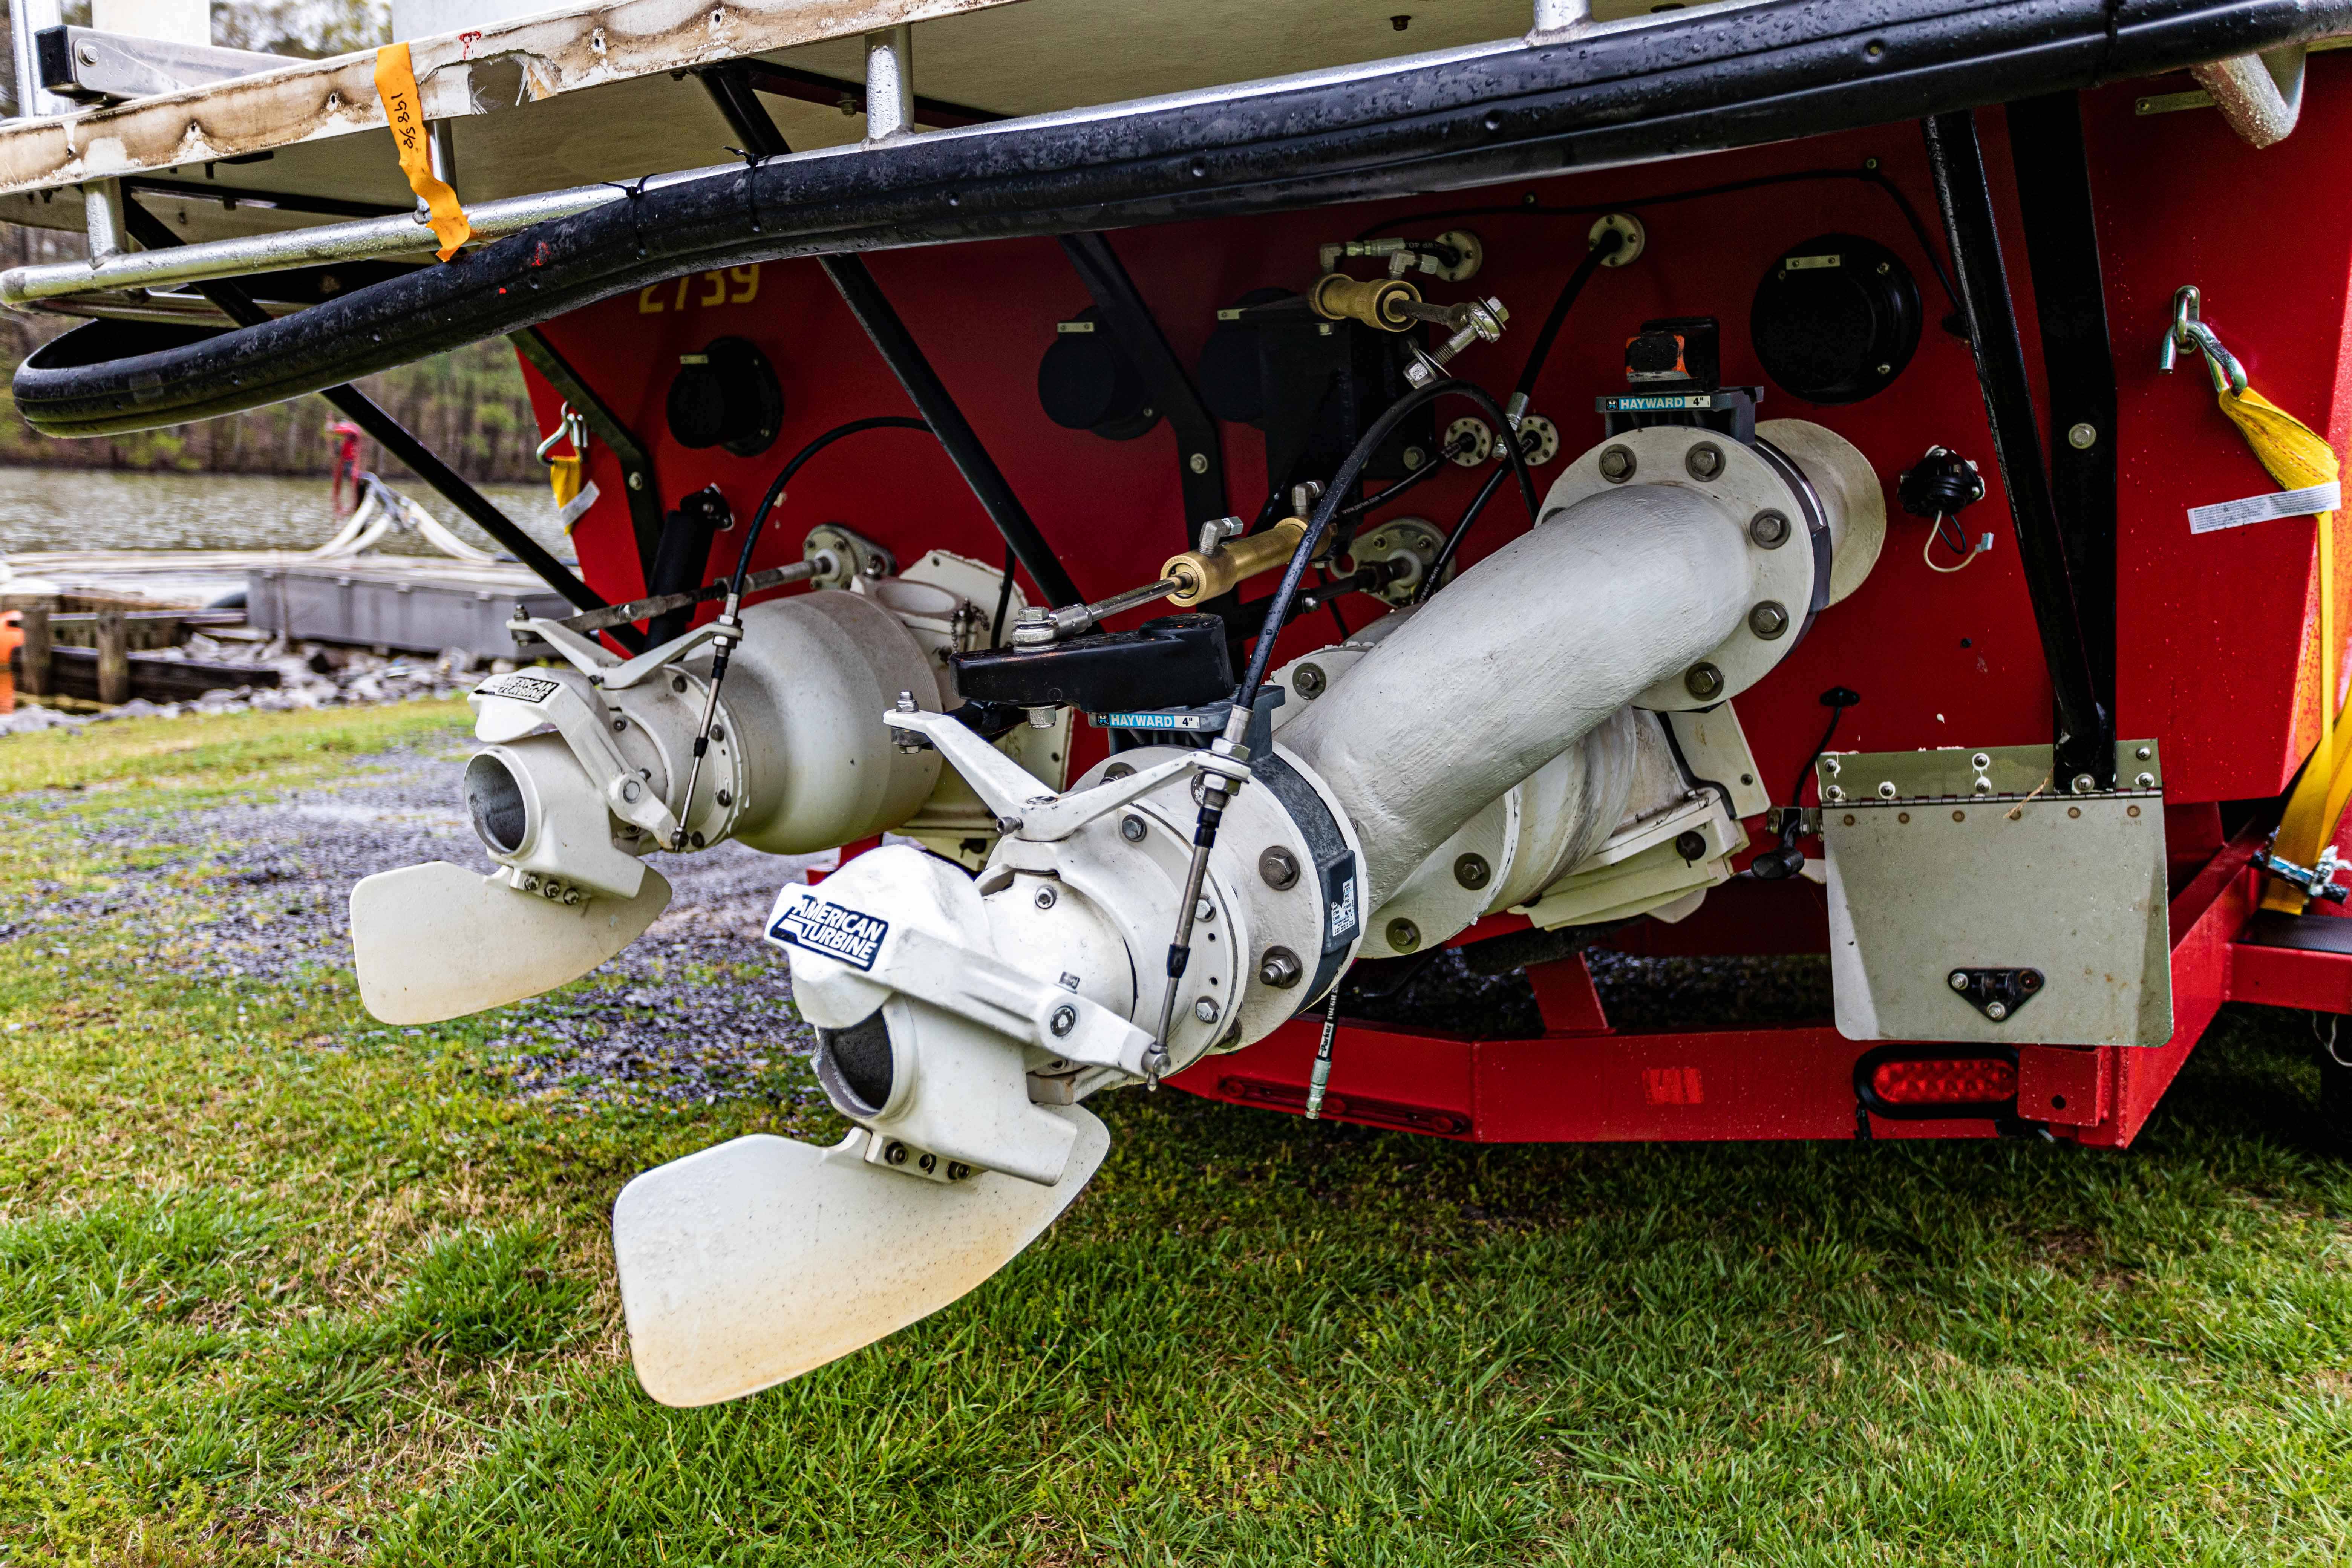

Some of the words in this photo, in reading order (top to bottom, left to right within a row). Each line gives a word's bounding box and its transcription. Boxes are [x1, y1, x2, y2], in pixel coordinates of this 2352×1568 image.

[1620, 397, 1683, 410] HAYWARD
[1693, 397, 1704, 406] 4"
[1110, 714, 1173, 727] HAYWARD
[1182, 717, 1193, 726] 4"
[791, 898, 885, 942] AMERICAN
[801, 923, 877, 960] TURBINE
[1320, 1024, 1331, 1051] Parker
[1326, 994, 1337, 1020] TOUGH
